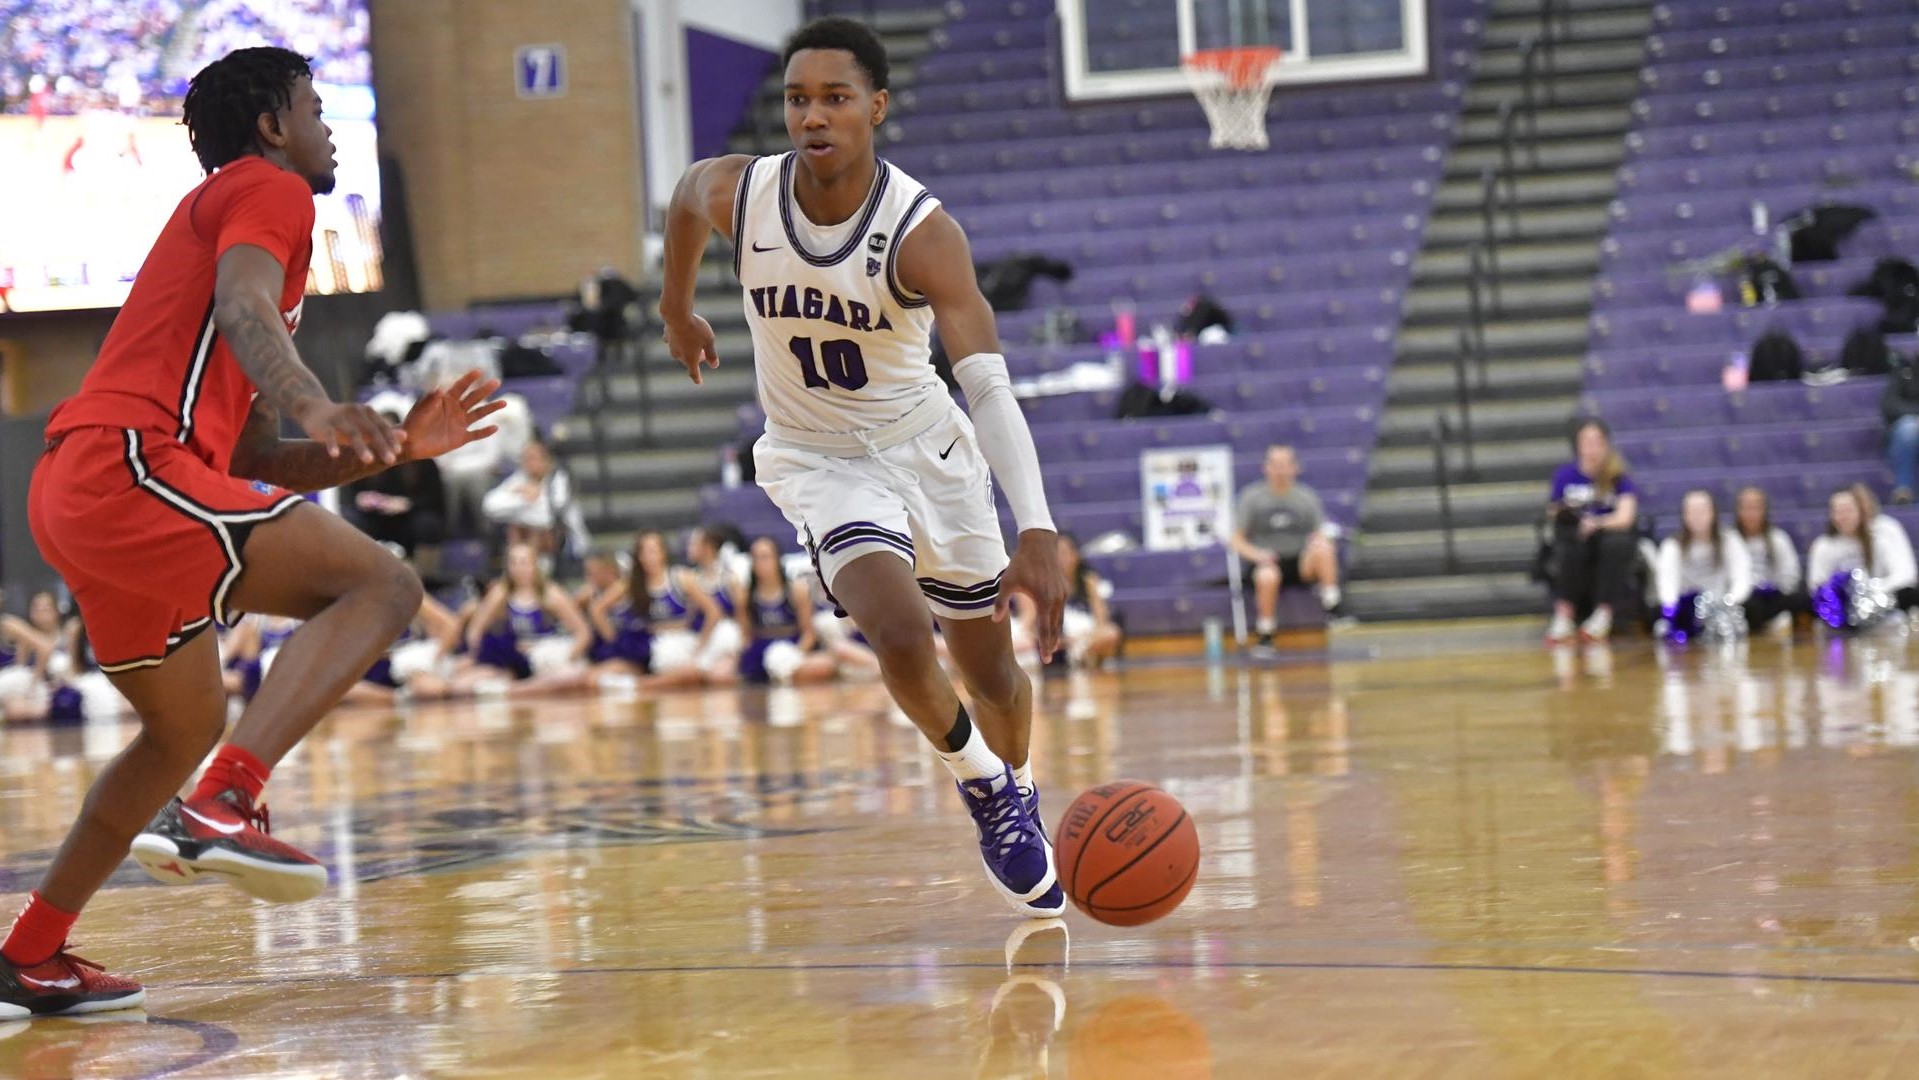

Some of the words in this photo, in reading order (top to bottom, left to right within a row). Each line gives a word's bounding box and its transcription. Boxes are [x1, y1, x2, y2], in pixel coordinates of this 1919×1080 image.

[525, 49, 553, 92] 7
[869, 236, 886, 248] BLM
[789, 335, 869, 391] 10
[1065, 801, 1099, 838] THE
